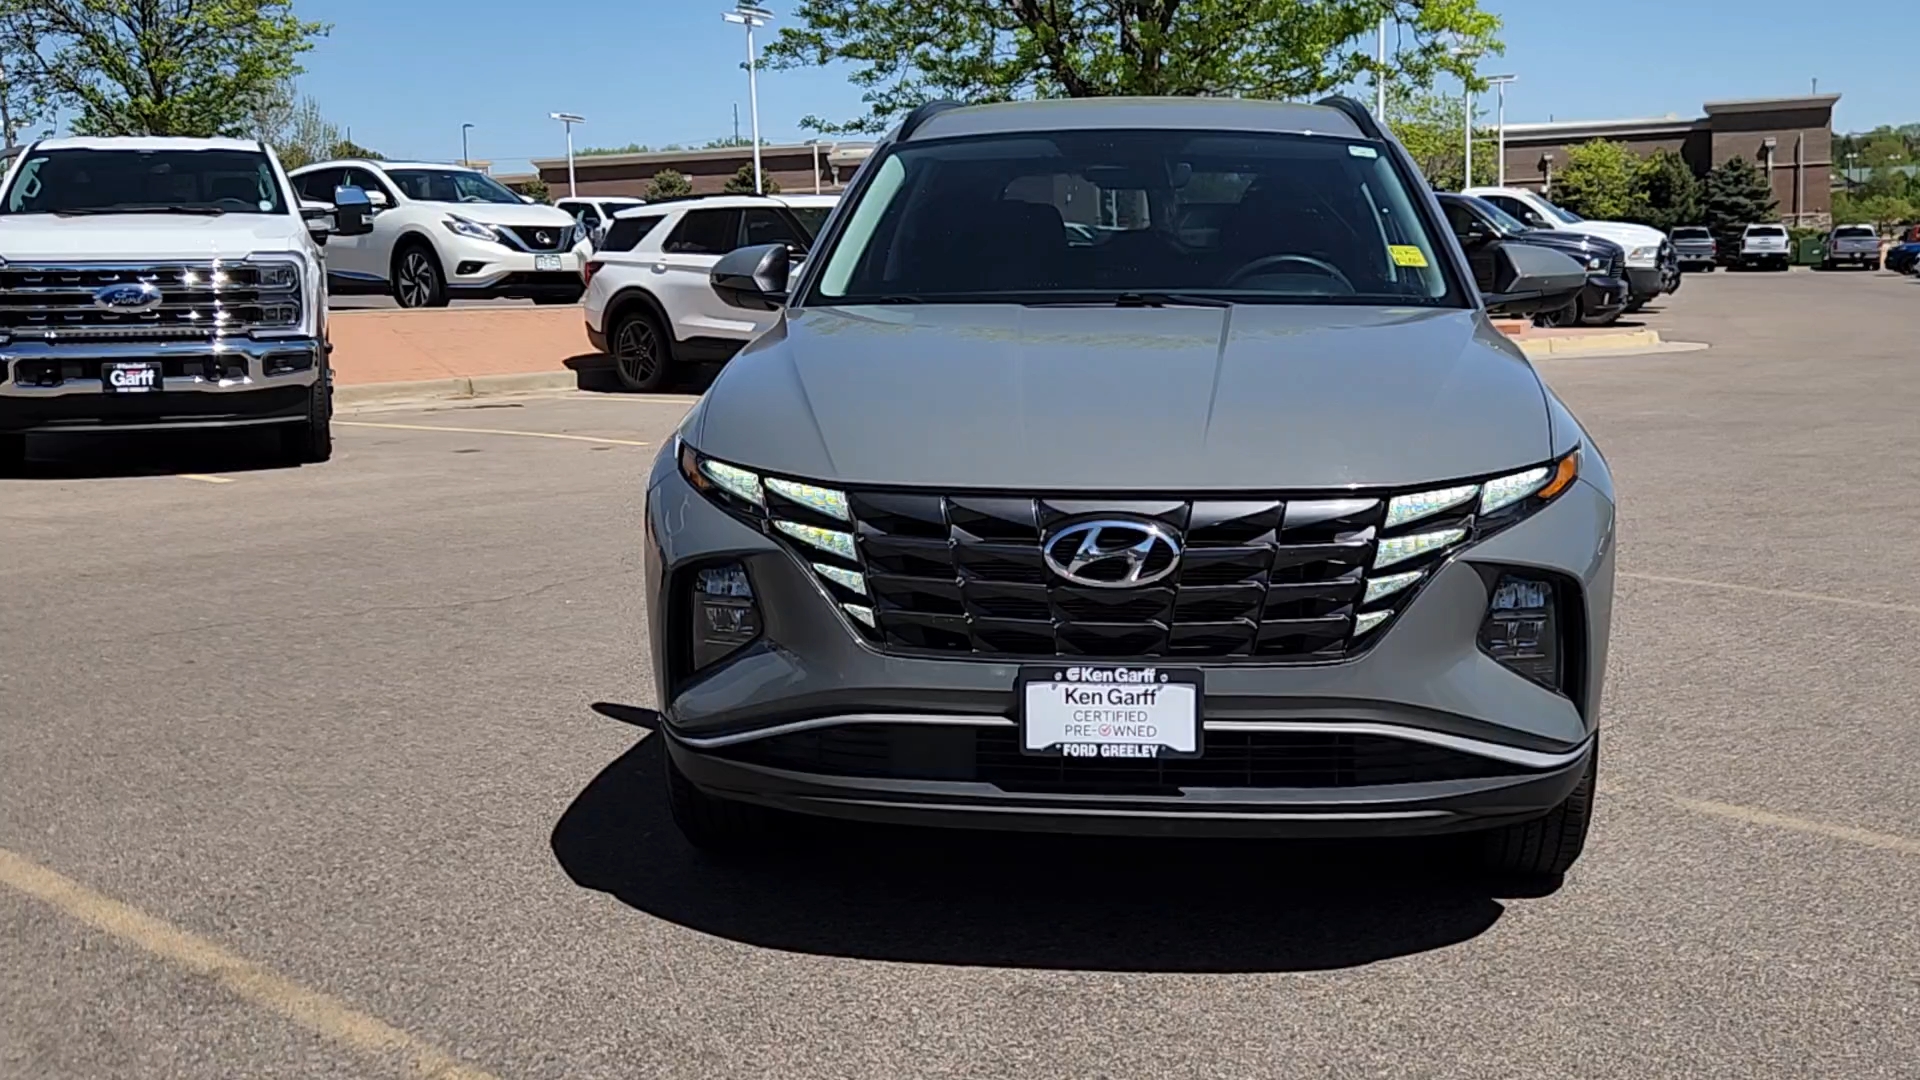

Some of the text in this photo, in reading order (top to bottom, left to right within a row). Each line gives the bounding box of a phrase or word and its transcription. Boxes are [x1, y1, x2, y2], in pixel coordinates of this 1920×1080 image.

[110, 369, 155, 386] Garff
[1081, 667, 1156, 683] Ken Garff
[1064, 687, 1156, 705] Ken Garff
[1073, 710, 1148, 722] CERTIFIED
[1063, 744, 1159, 758] FORD GREELEY
